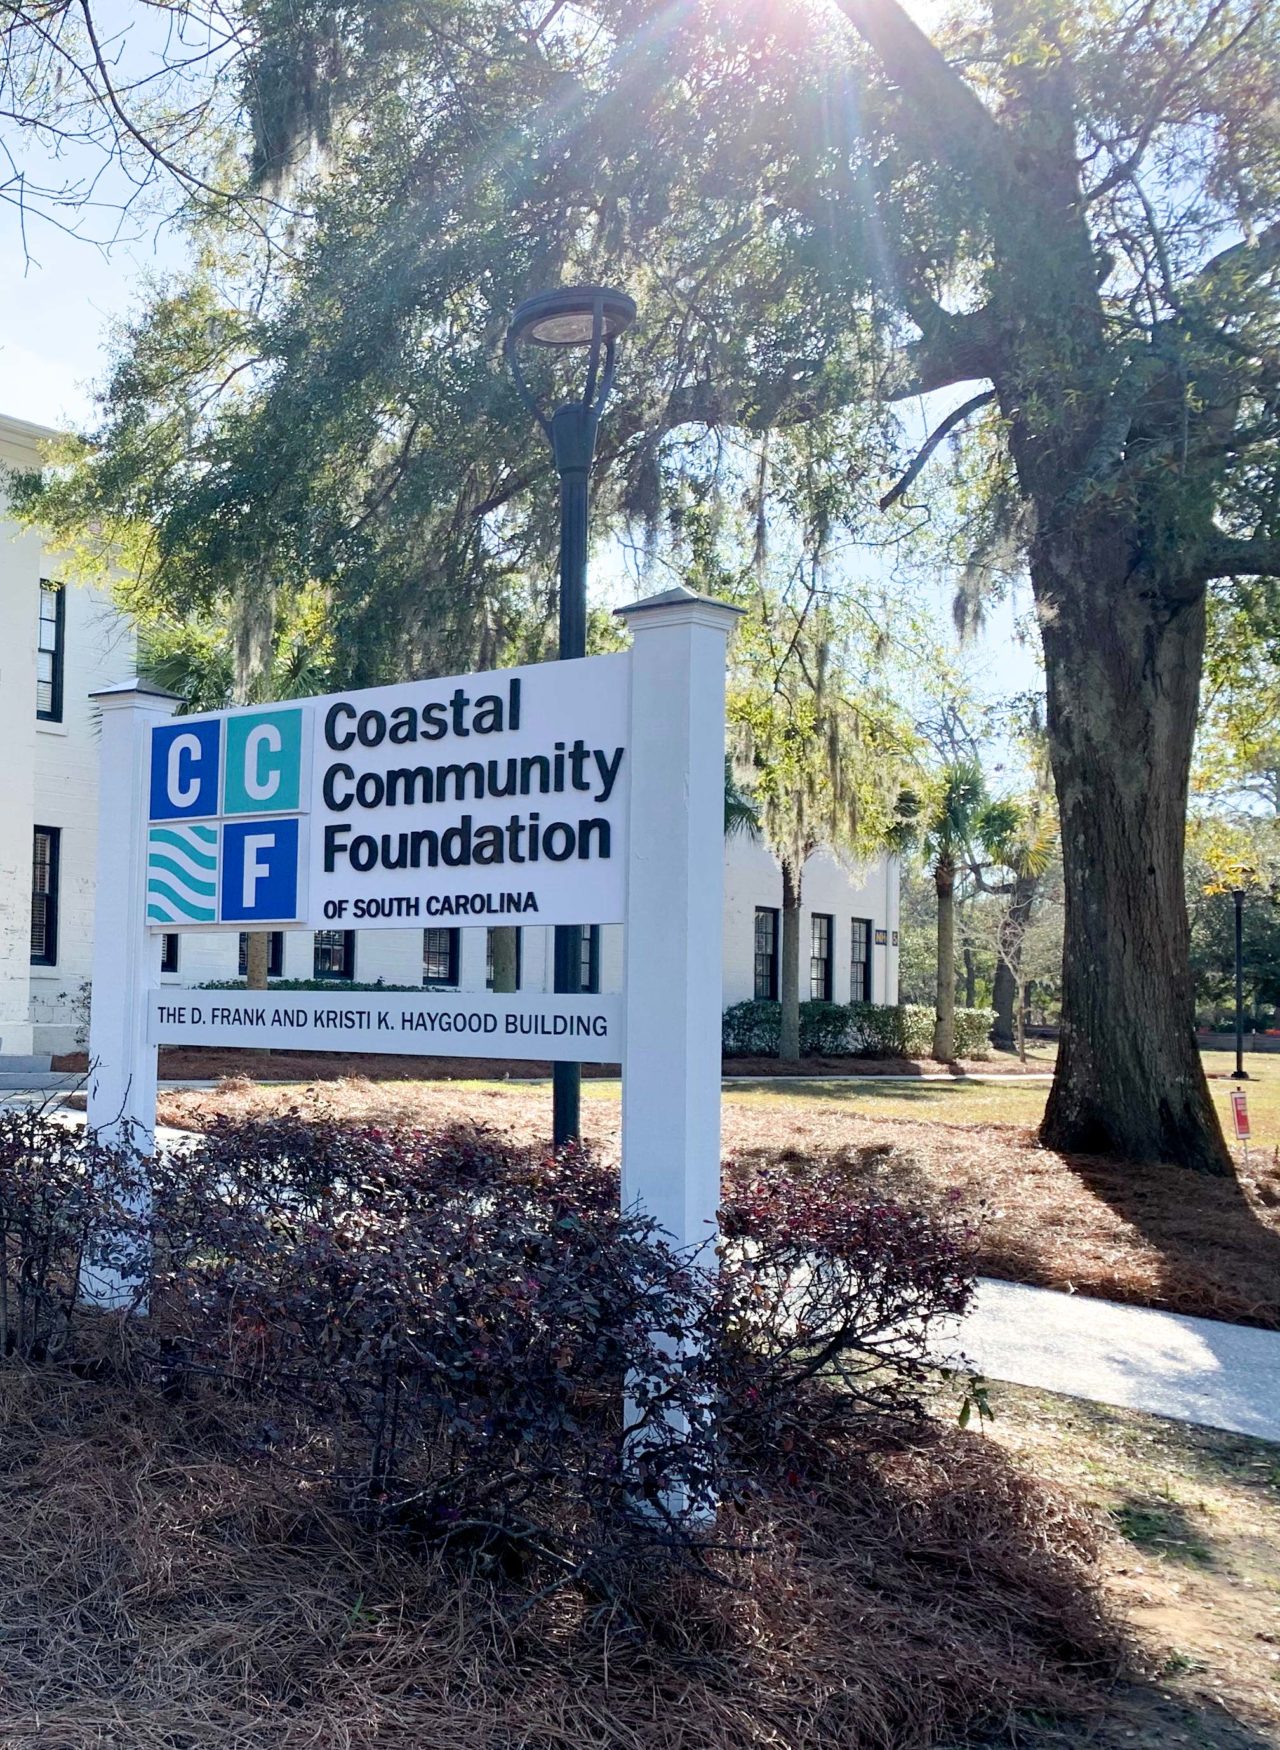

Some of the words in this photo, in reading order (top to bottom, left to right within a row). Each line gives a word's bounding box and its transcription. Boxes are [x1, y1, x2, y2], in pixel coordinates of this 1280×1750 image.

[324, 678, 520, 752] Coastal
[167, 733, 201, 808] C
[244, 723, 281, 801] C
[322, 740, 624, 812] Community
[242, 833, 275, 908] F
[323, 812, 612, 873] Foundation
[323, 900, 349, 919] OF
[352, 897, 420, 918] SOUTH
[426, 892, 539, 916] CAROLINA
[157, 1006, 187, 1024] THE
[191, 1007, 206, 1025] D.
[211, 1007, 266, 1027] FRANK
[270, 1009, 308, 1028] AND
[313, 1010, 371, 1030] KRISTI
[377, 1011, 395, 1030] K.
[401, 1012, 498, 1034] HAYGOOD
[505, 1014, 608, 1037] BUILDING
